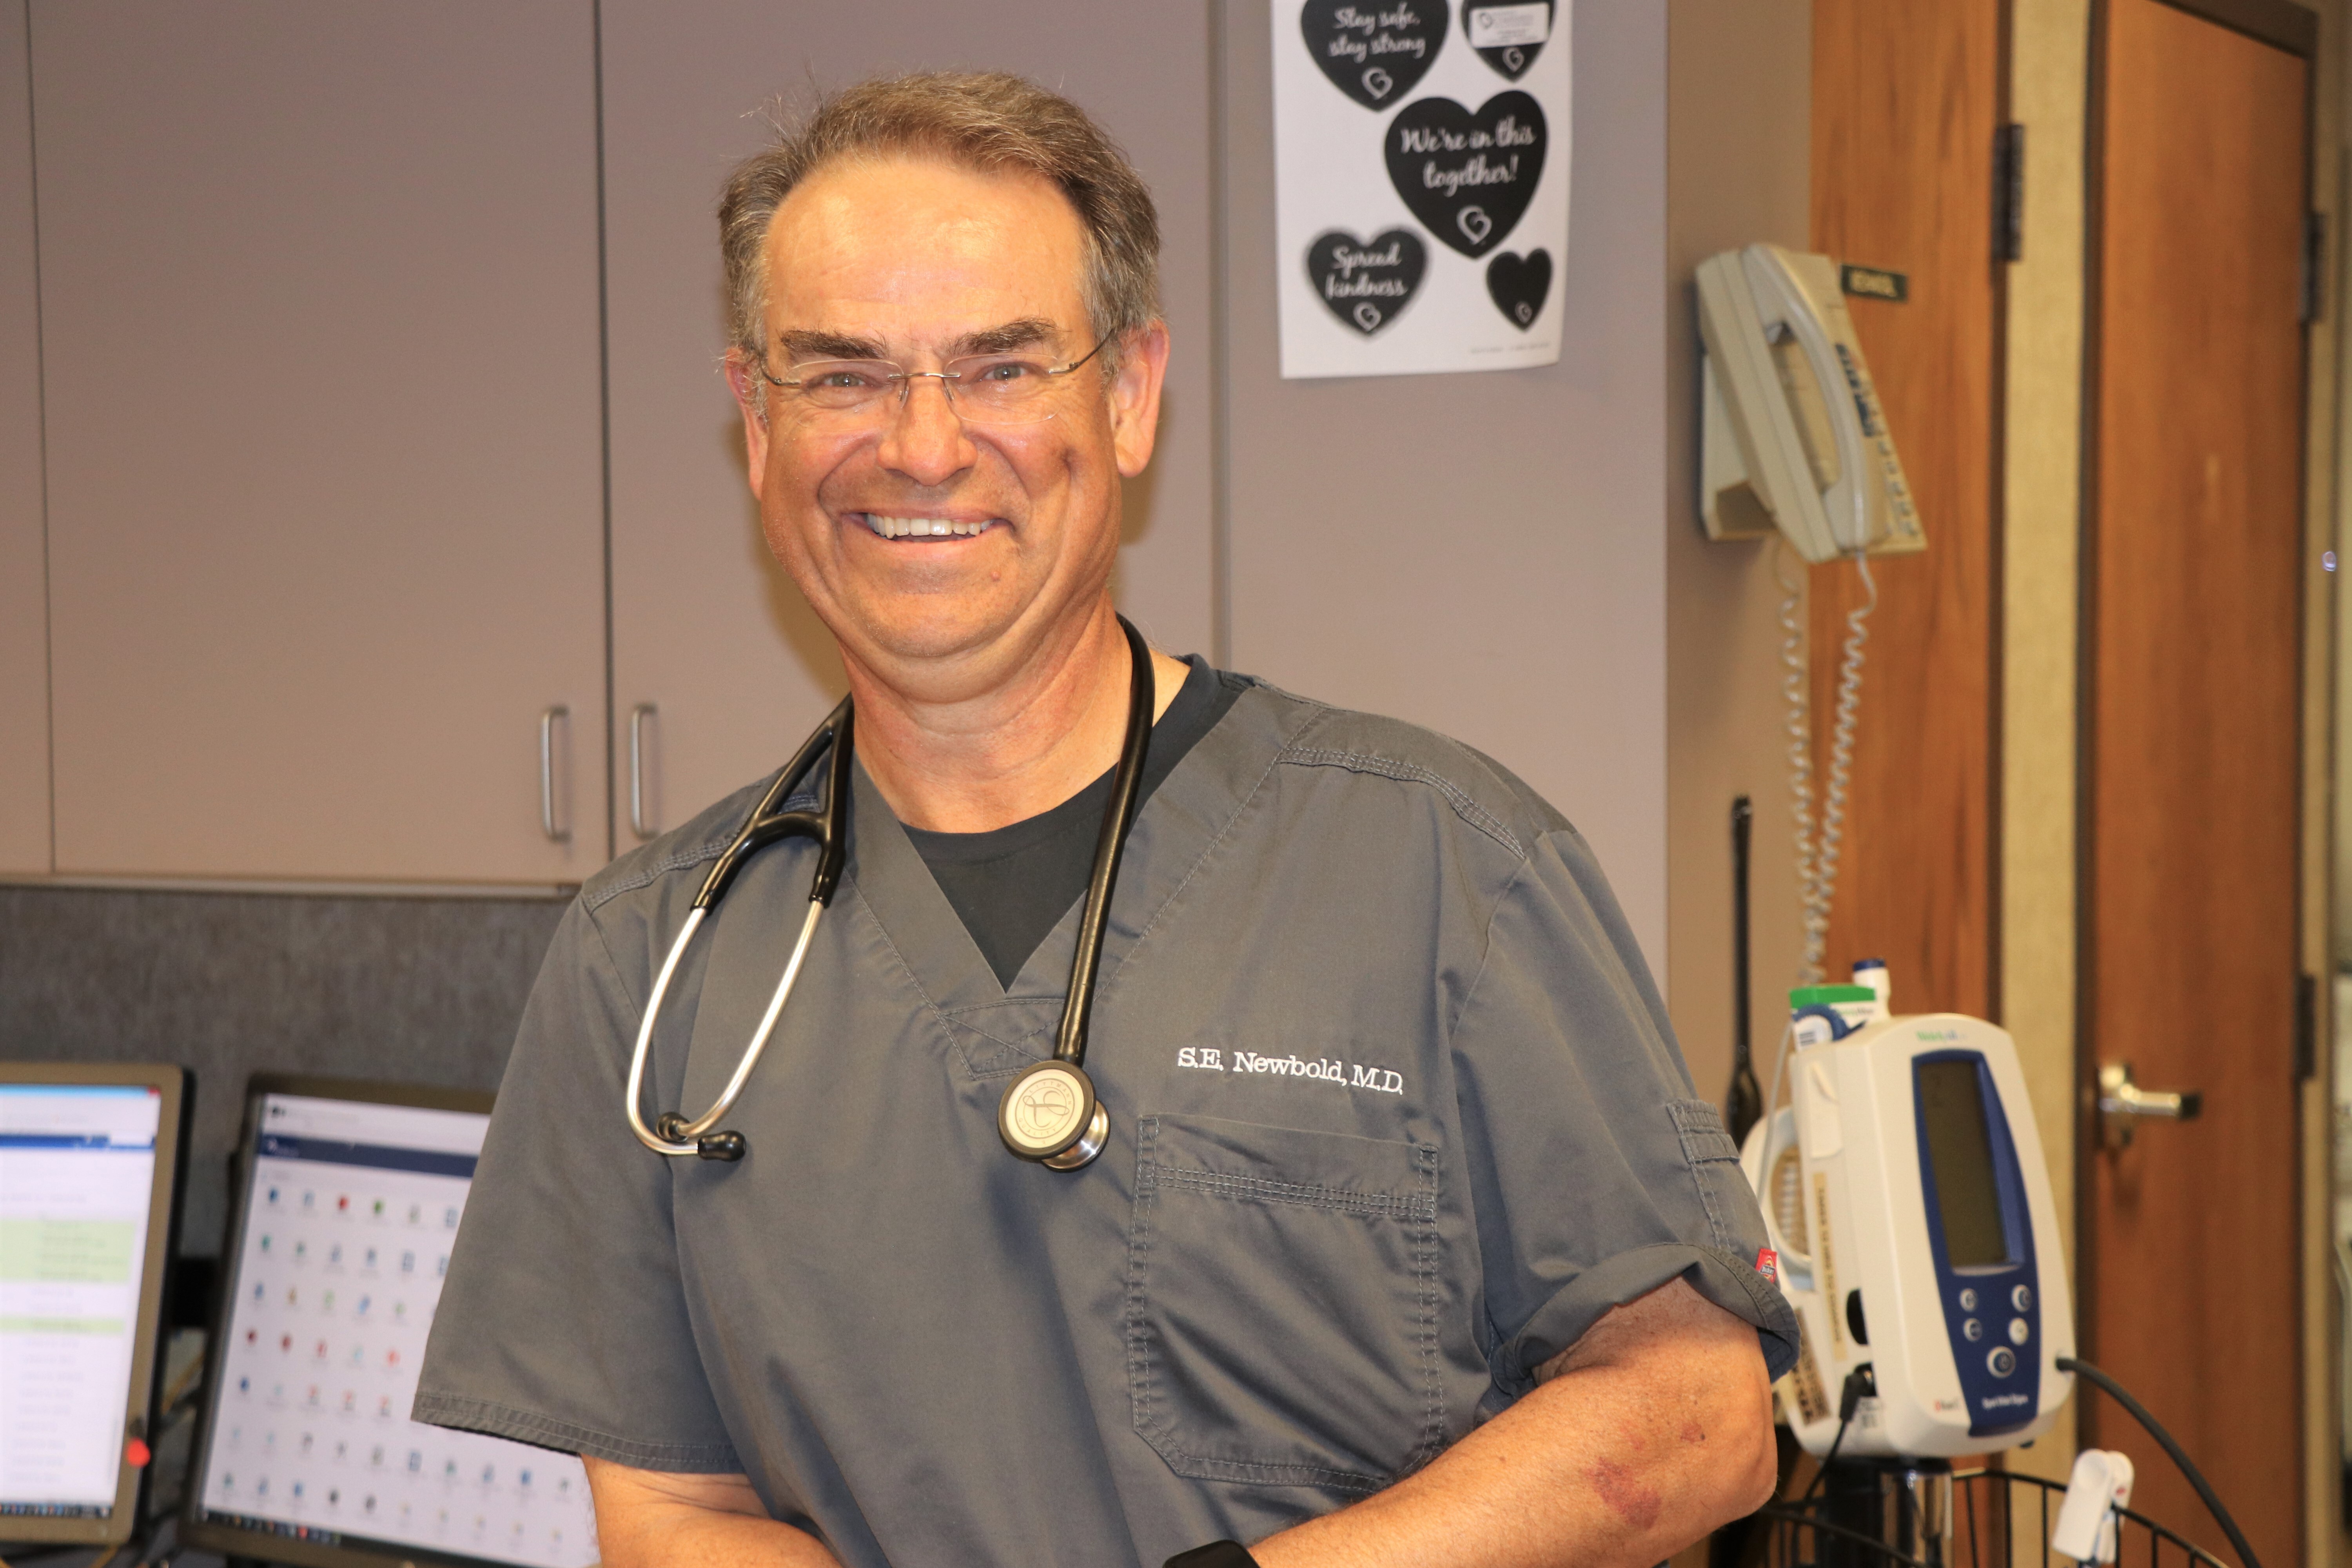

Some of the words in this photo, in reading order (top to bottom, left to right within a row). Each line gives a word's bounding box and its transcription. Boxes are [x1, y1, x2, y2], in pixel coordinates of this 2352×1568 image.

[1332, 5, 1376, 36] Stay
[1328, 33, 1367, 64] stay
[1368, 32, 1426, 59] strong
[1401, 127, 1467, 154] We're
[1469, 127, 1494, 149] in
[1495, 114, 1537, 147] this
[1423, 153, 1519, 197] together!
[1332, 242, 1401, 279] Spread
[1326, 273, 1407, 299] kindness
[1178, 1047, 1224, 1071] S.E.
[1233, 1051, 1348, 1087] Newbold,
[1351, 1064, 1403, 1095] M.D.
[1029, 1081, 1072, 1105] LITTMANN
[1019, 1117, 1056, 1136] QUALITY
